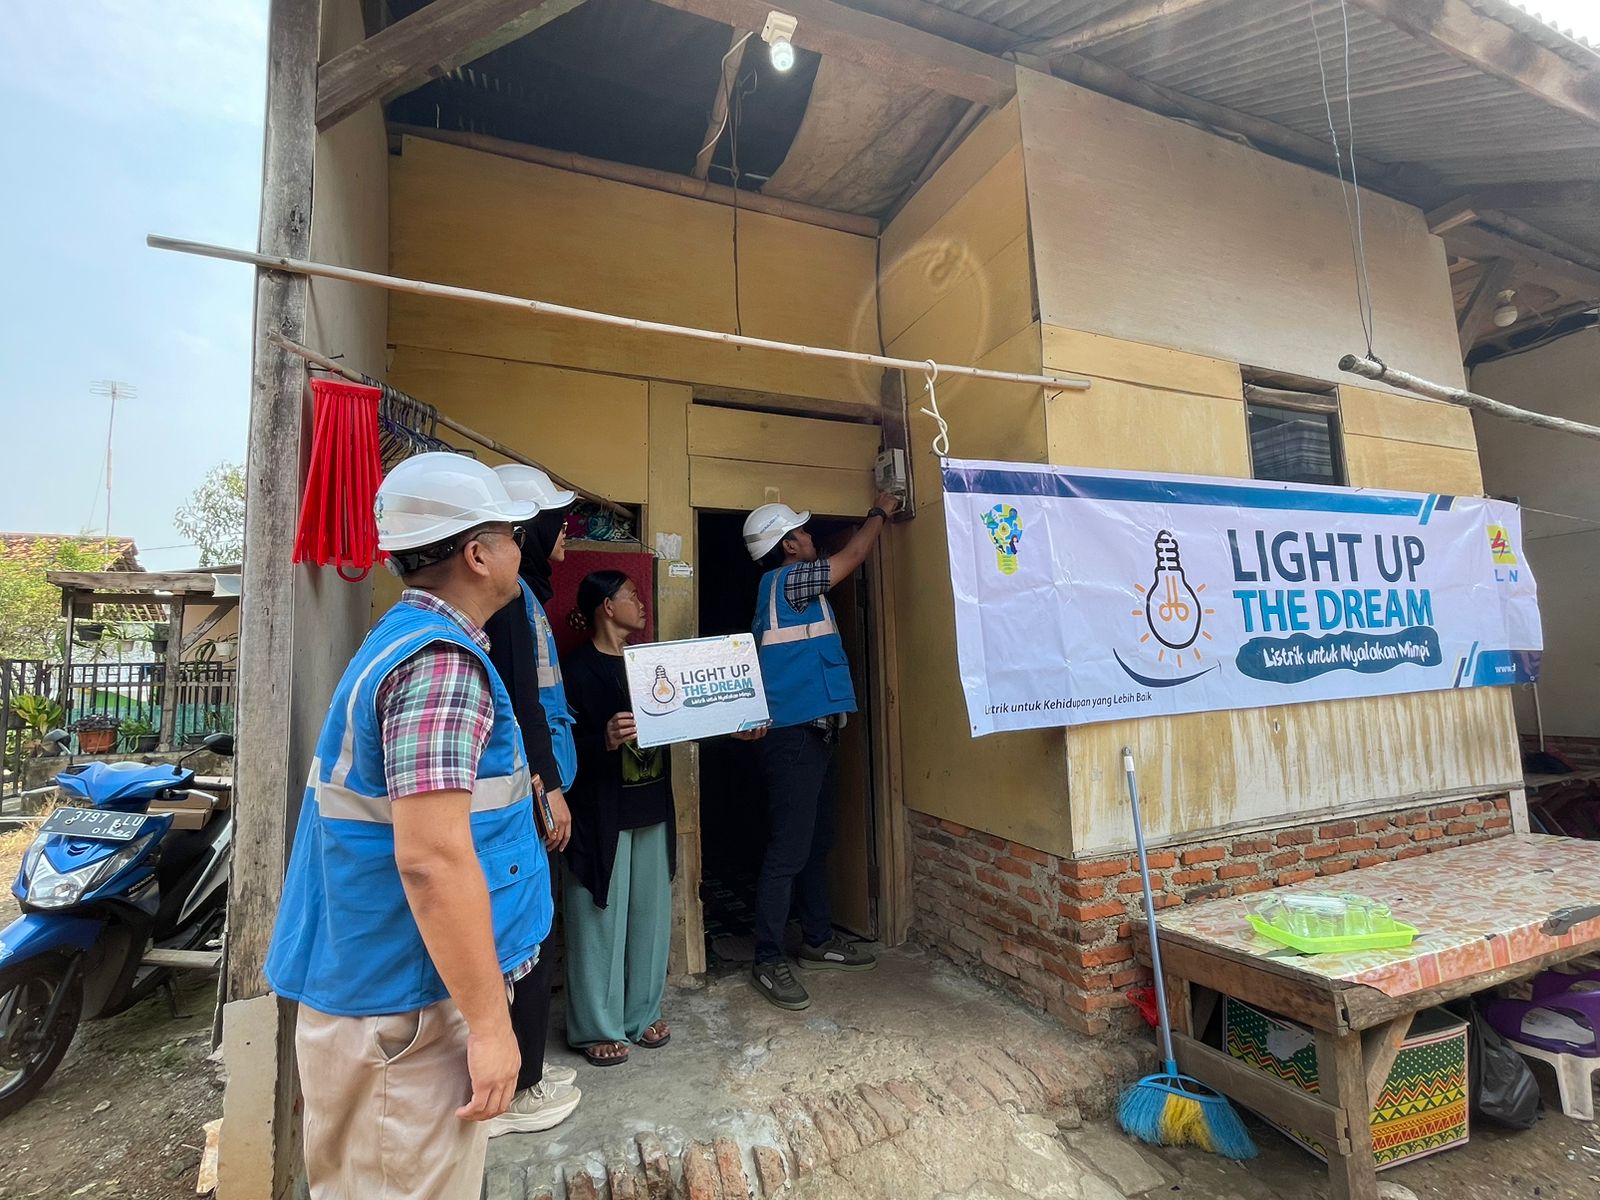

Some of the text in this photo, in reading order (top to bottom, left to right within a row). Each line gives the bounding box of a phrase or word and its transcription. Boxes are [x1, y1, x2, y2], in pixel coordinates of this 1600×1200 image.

[1227, 530, 1425, 583] LIGHT UP
[1233, 589, 1434, 632] THE DREAM
[1263, 641, 1430, 668] Listrik untuk Nyalakan Mimpi
[680, 664, 750, 685] LIGHT UP
[682, 677, 753, 697] THE DREAM
[1011, 700, 1041, 713] untuk
[1043, 697, 1091, 710] Kehidupan
[1092, 697, 1112, 709] yang
[1113, 693, 1135, 704] Lebih
[53, 809, 144, 826] T 3797 LU
